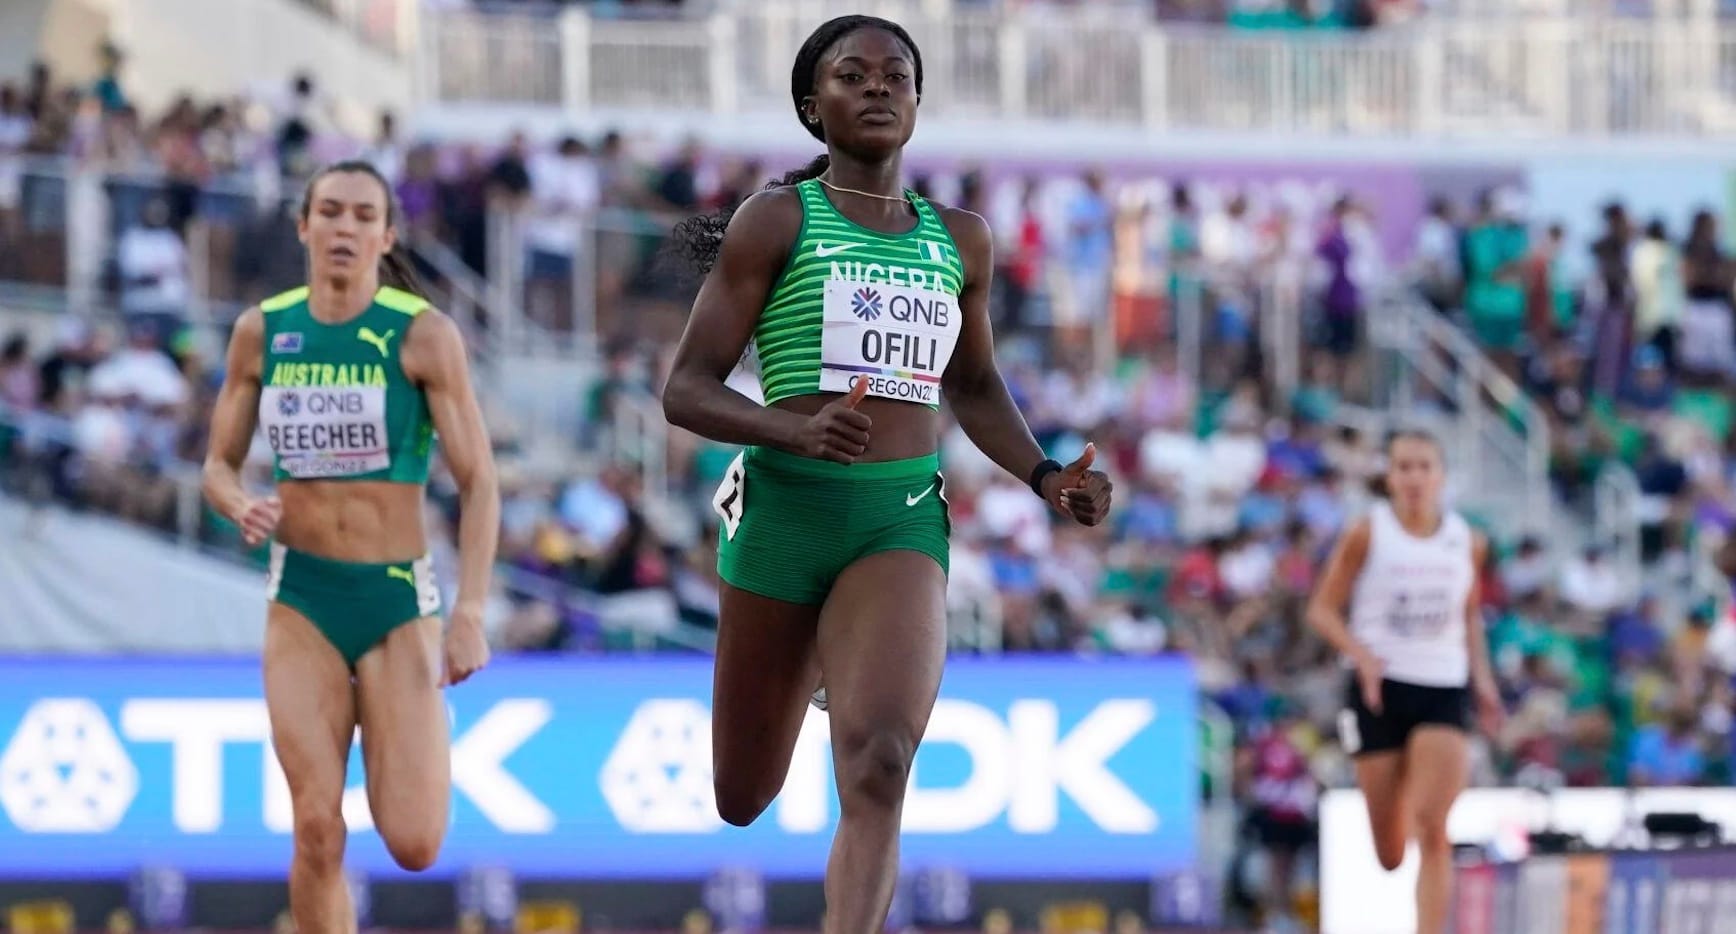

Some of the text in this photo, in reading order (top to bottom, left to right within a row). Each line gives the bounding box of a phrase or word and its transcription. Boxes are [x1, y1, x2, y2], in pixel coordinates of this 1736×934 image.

[889, 295, 949, 327] QNB
[861, 329, 937, 372] OFILI
[271, 363, 387, 387] AUSTRALIA
[308, 393, 362, 413] QNB
[268, 424, 377, 450] BEECHER
[119, 699, 557, 833] TK
